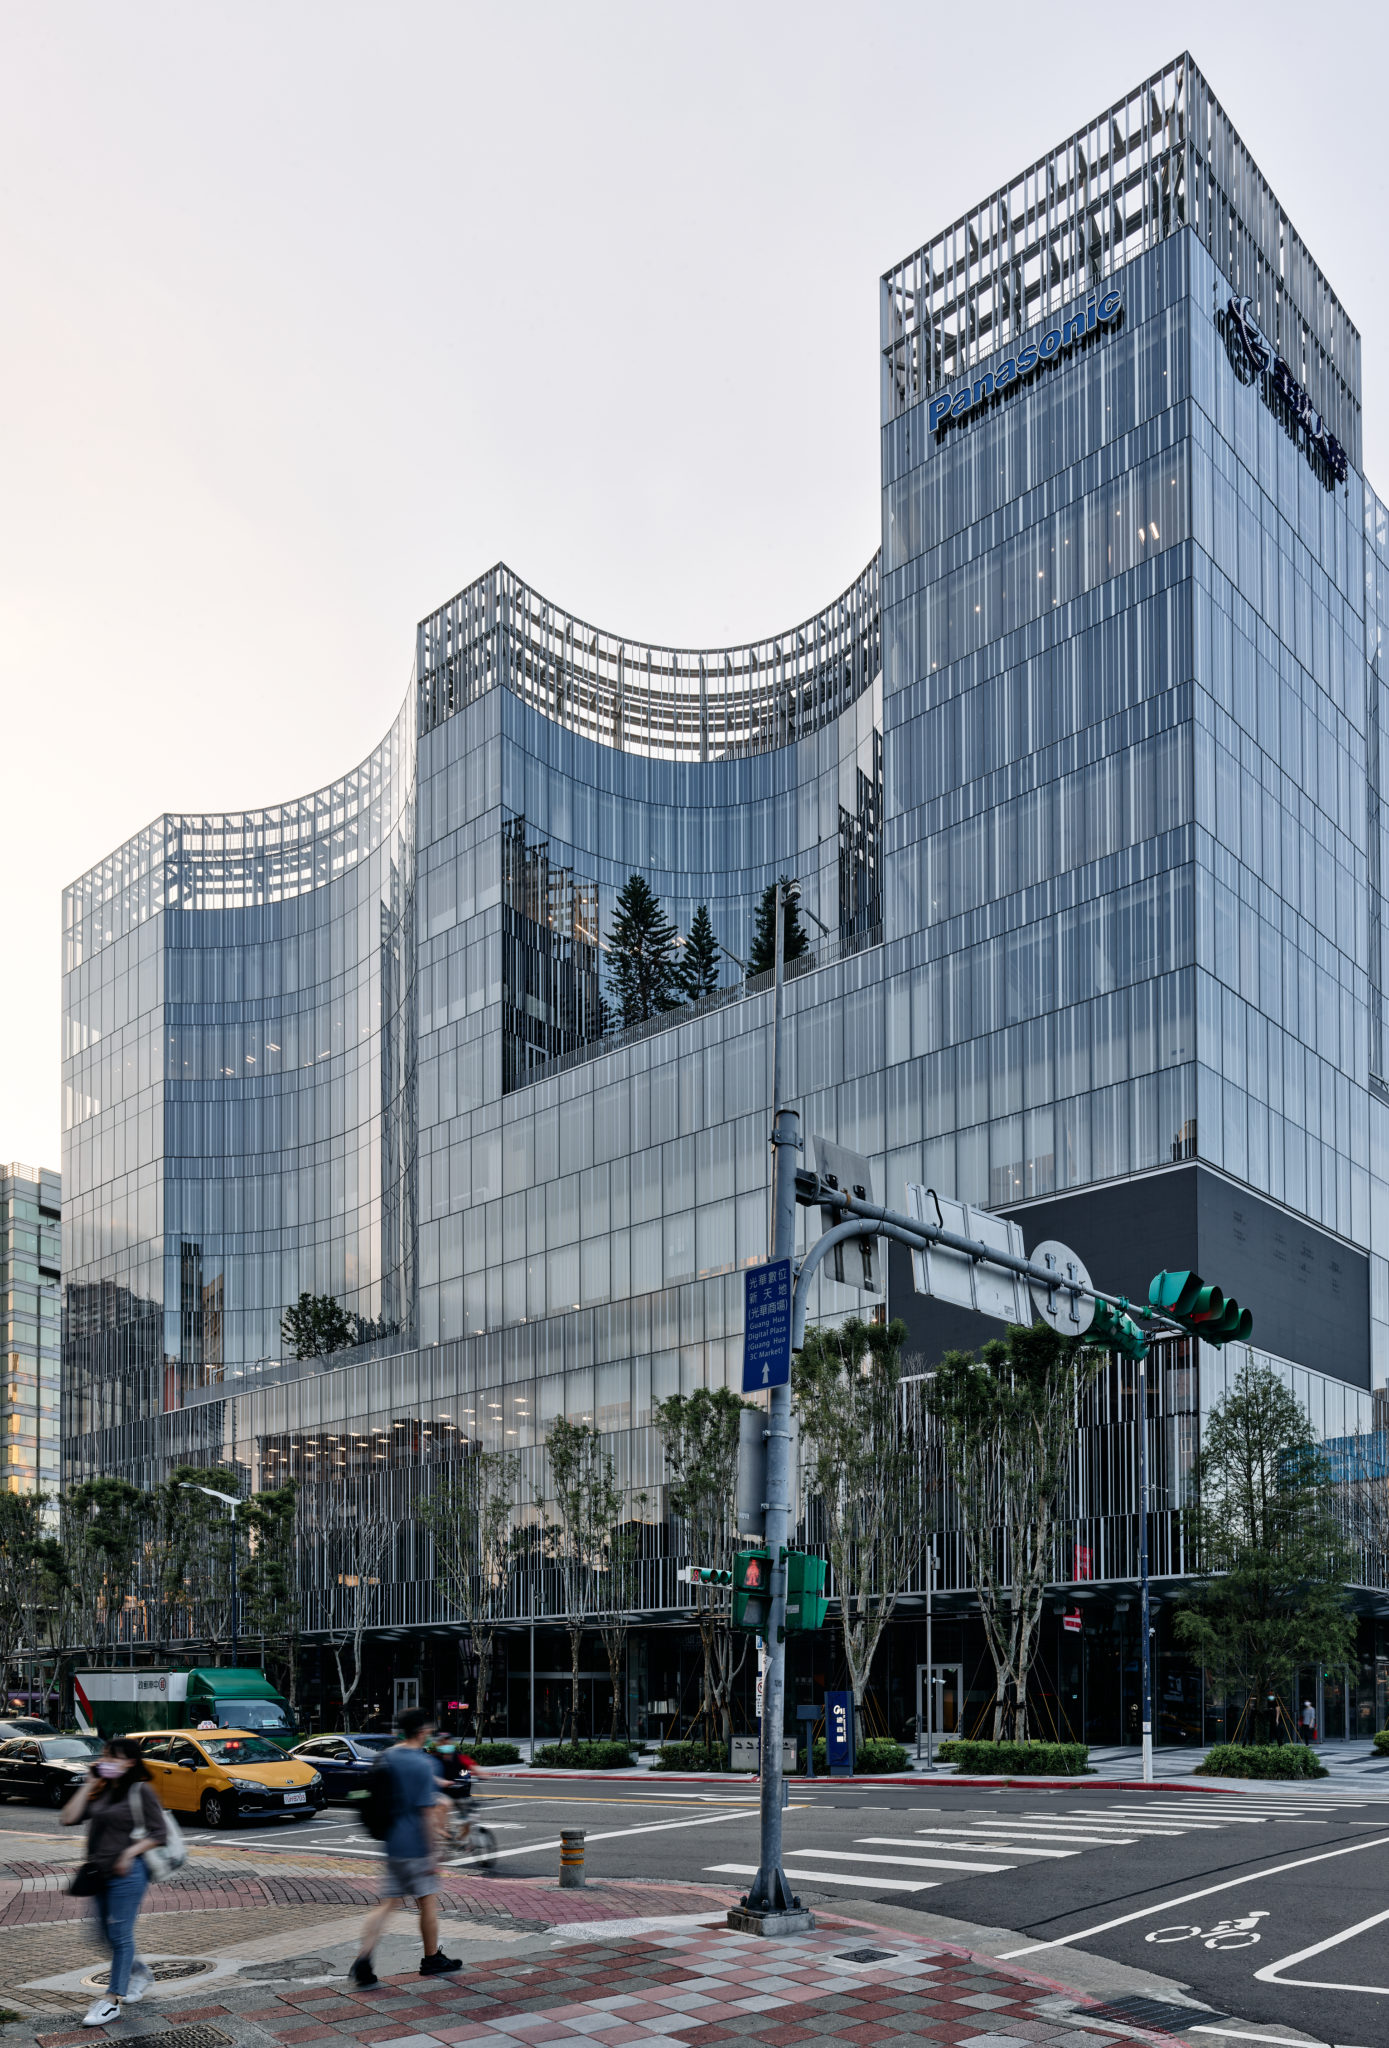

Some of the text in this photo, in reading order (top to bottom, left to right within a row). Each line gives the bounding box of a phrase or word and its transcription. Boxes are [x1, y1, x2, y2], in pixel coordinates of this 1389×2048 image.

[928, 290, 1121, 434] Panasonic
[749, 1268, 787, 1289] 光華數位
[750, 1315, 785, 1329] Guang Hua
[748, 1326, 786, 1341] Digital Plaza
[747, 1336, 786, 1352] (Guang Hua
[749, 1346, 783, 1360] 3C Market)
